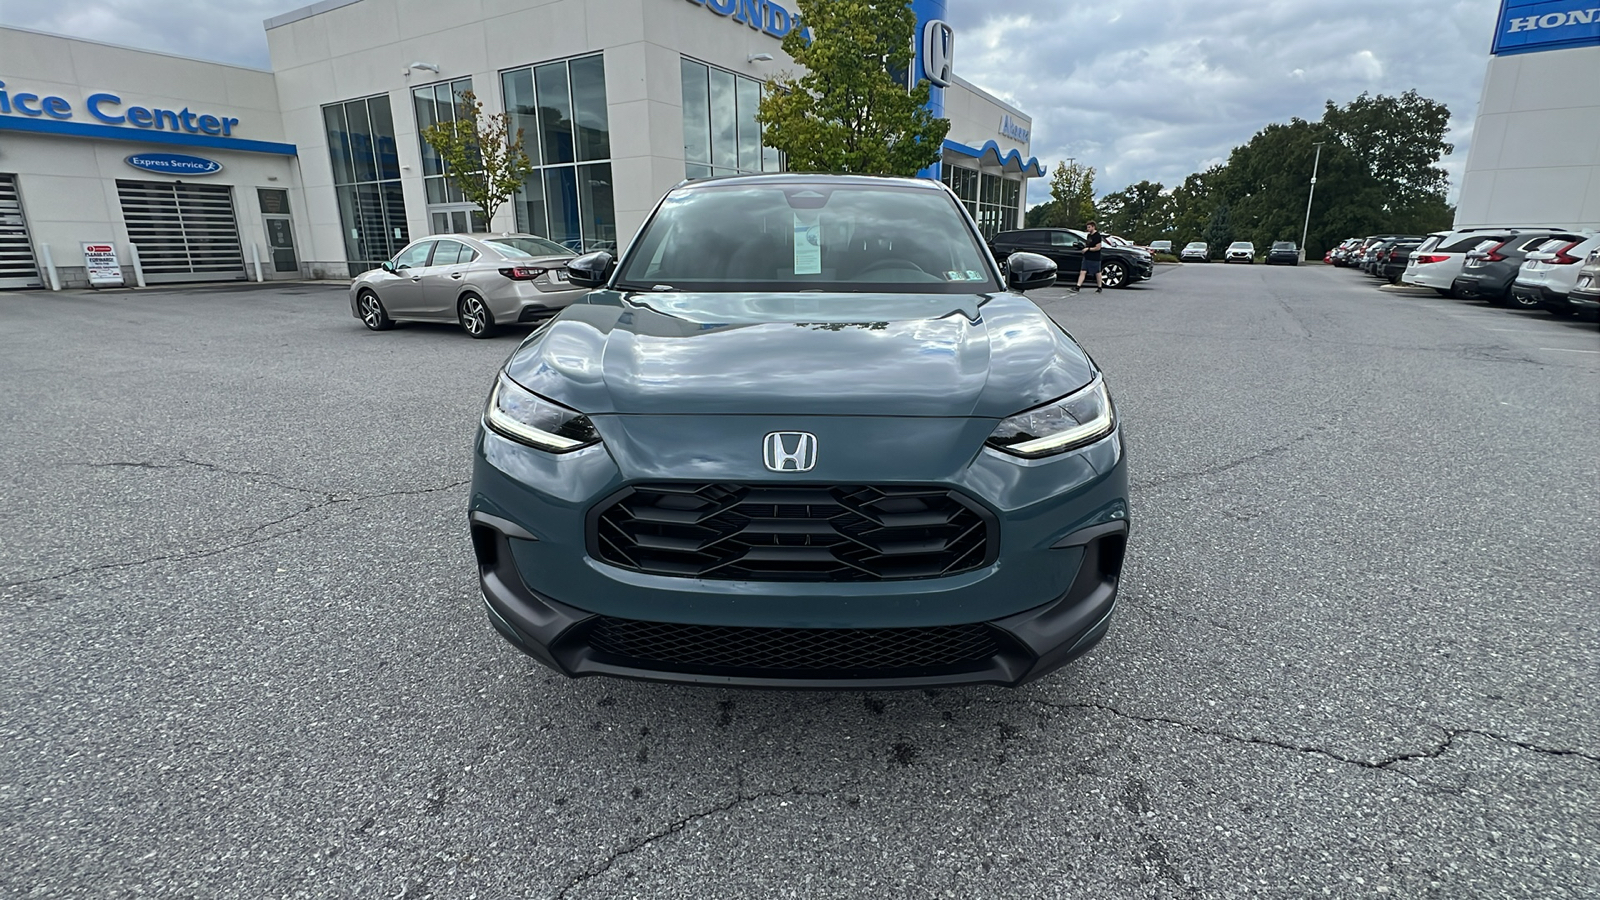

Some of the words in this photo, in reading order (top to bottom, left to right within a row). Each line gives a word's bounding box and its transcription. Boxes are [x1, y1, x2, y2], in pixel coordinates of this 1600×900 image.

[685, 0, 812, 48] OND
[1507, 8, 1600, 33] HON
[87, 93, 239, 136] Center
[132, 157, 169, 167] Express
[170, 159, 204, 169] Service
